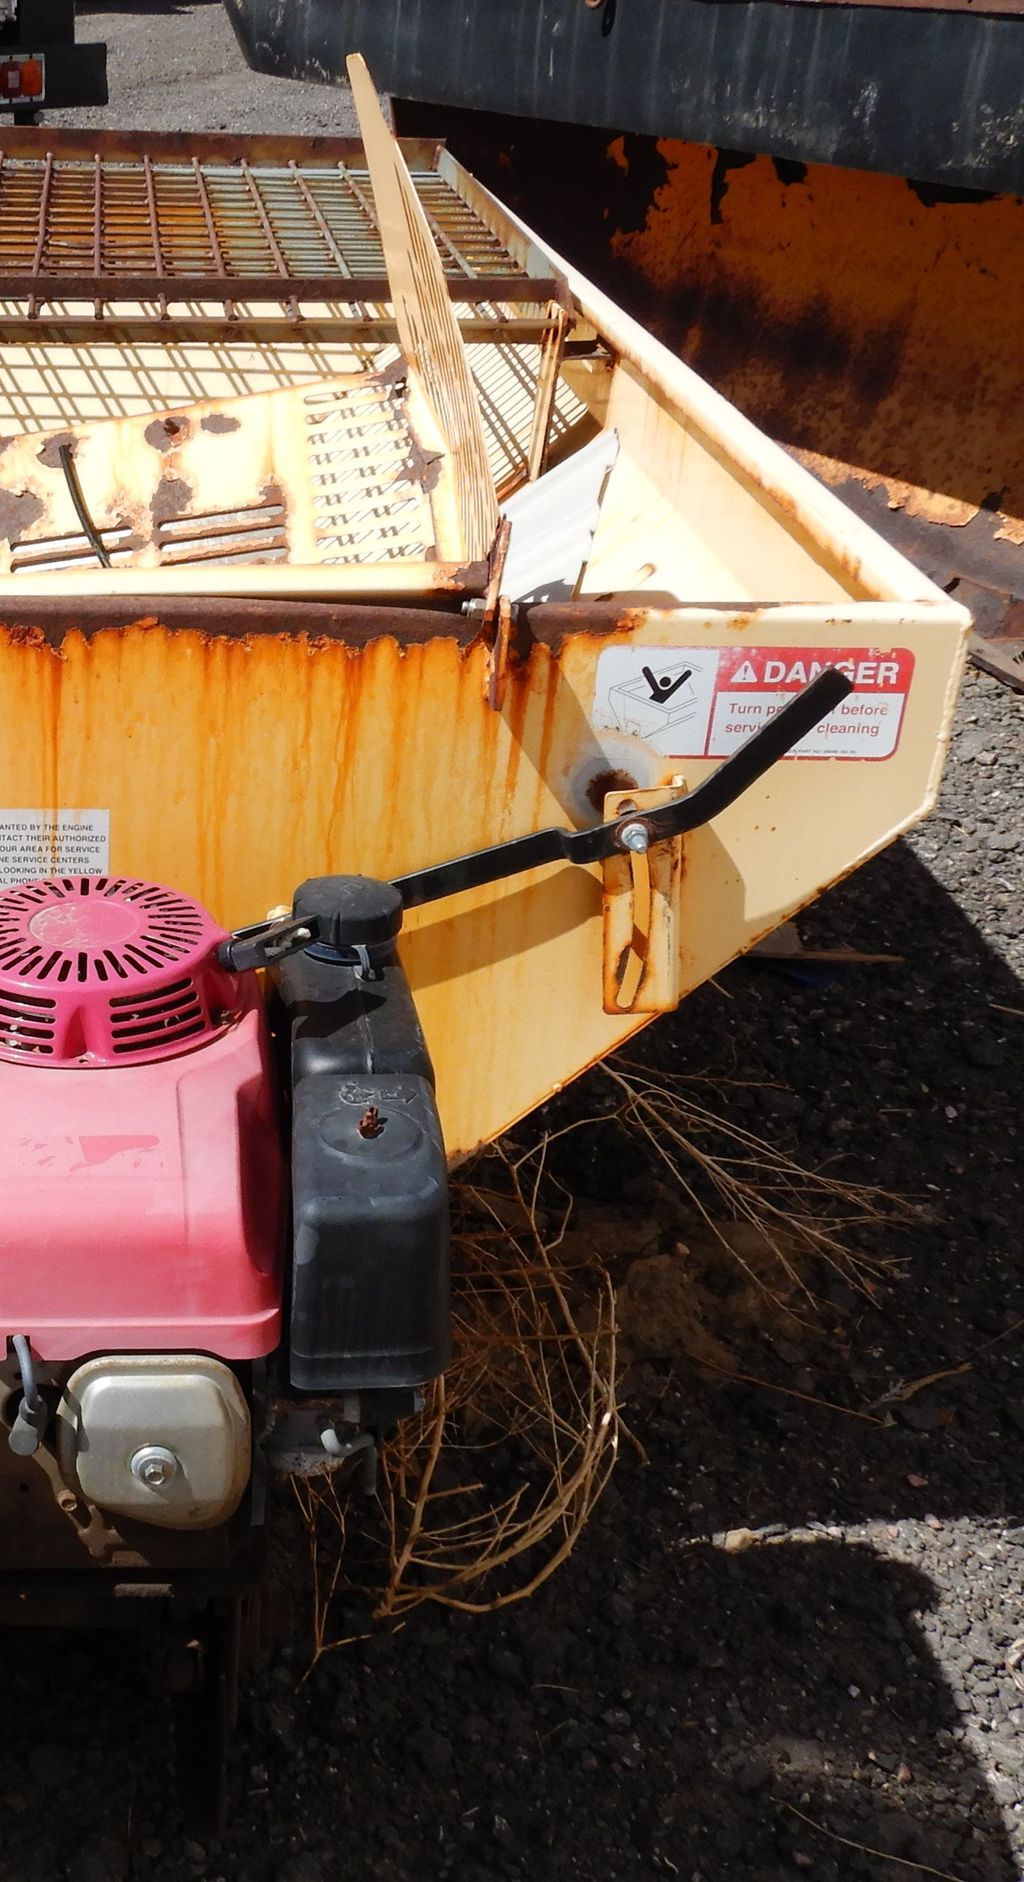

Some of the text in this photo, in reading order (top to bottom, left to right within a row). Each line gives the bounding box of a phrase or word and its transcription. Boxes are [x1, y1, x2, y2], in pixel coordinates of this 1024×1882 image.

[729, 703, 762, 714] Turn
[841, 704, 888, 715] before
[817, 724, 880, 736] cleaning
